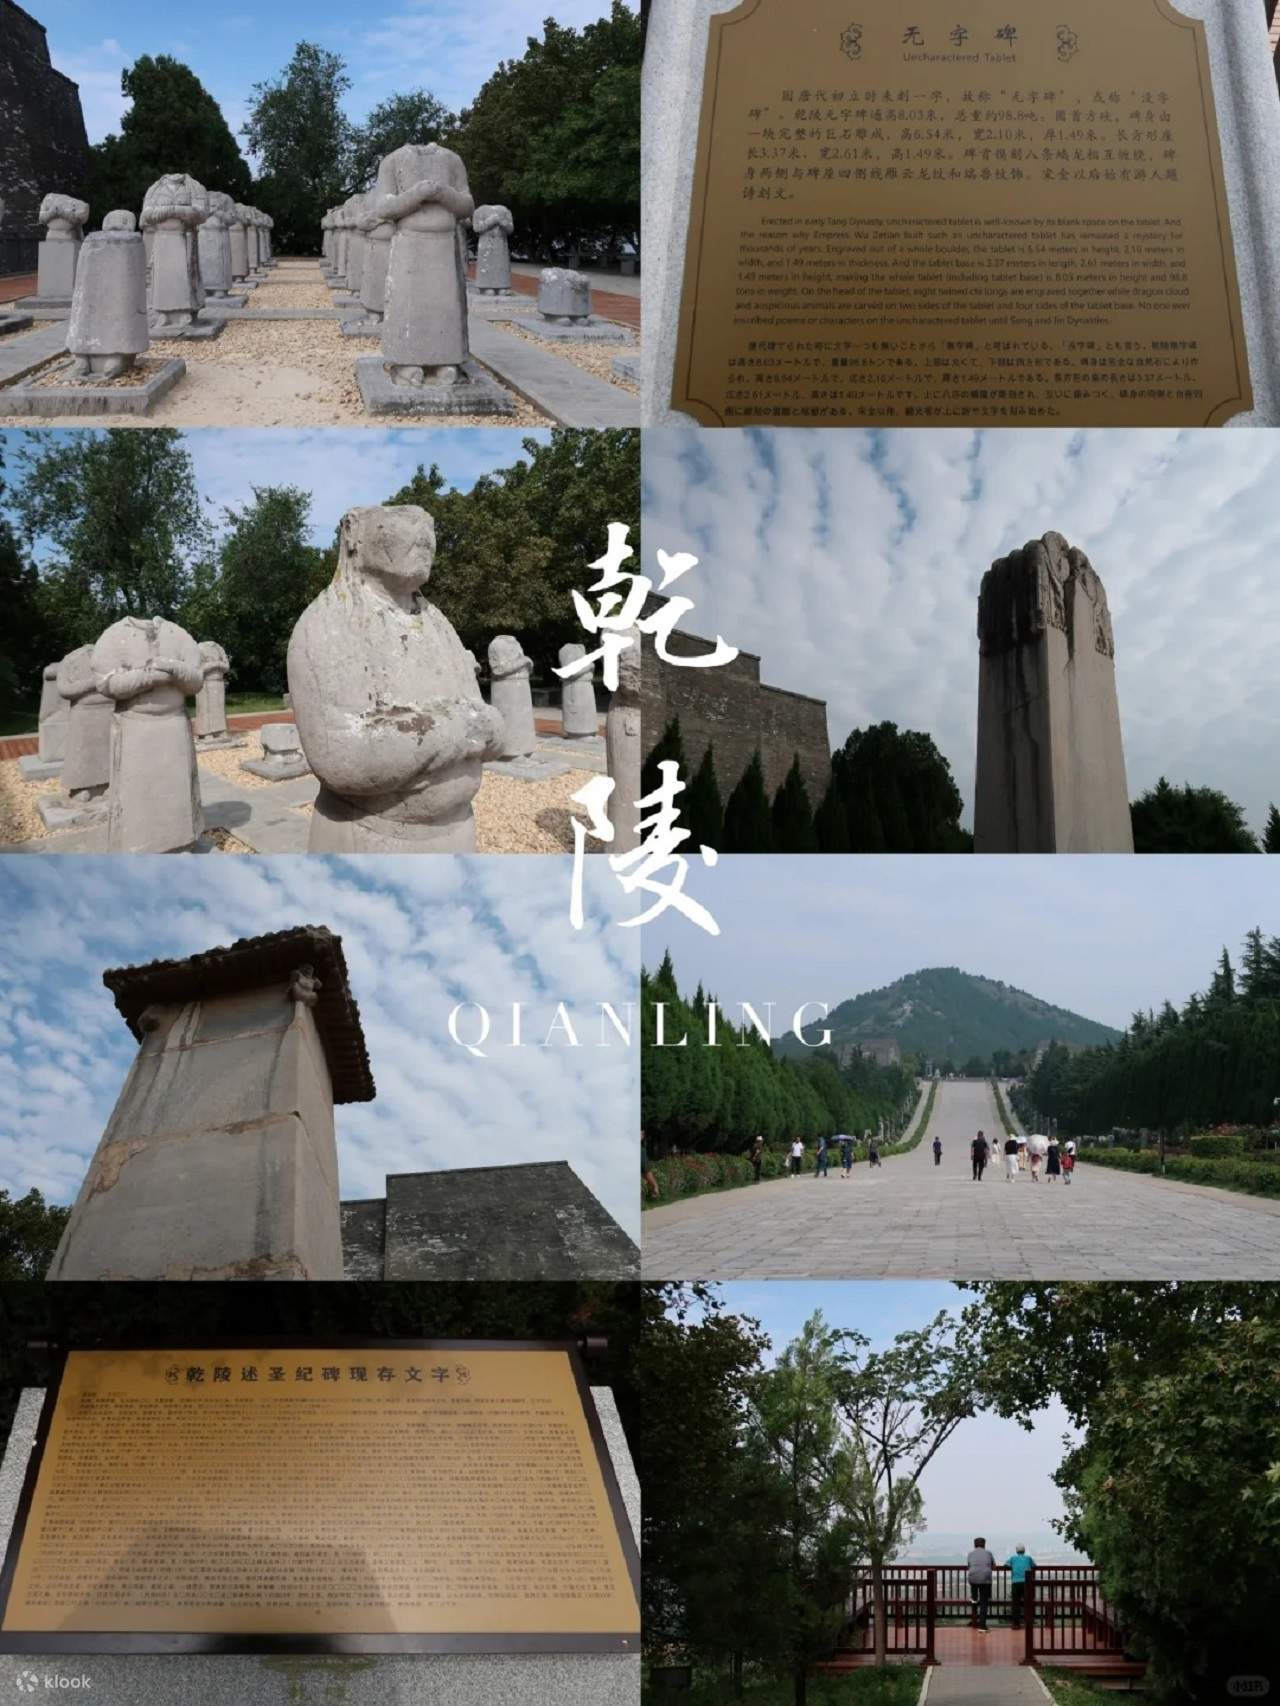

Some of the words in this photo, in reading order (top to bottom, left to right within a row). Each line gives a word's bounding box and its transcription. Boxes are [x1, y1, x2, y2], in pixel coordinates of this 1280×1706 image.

[902, 24, 1018, 47] 无字碑
[984, 52, 1016, 62] Tablet
[185, 1366, 451, 1384] 乾陵述圣纪碑现存文字
